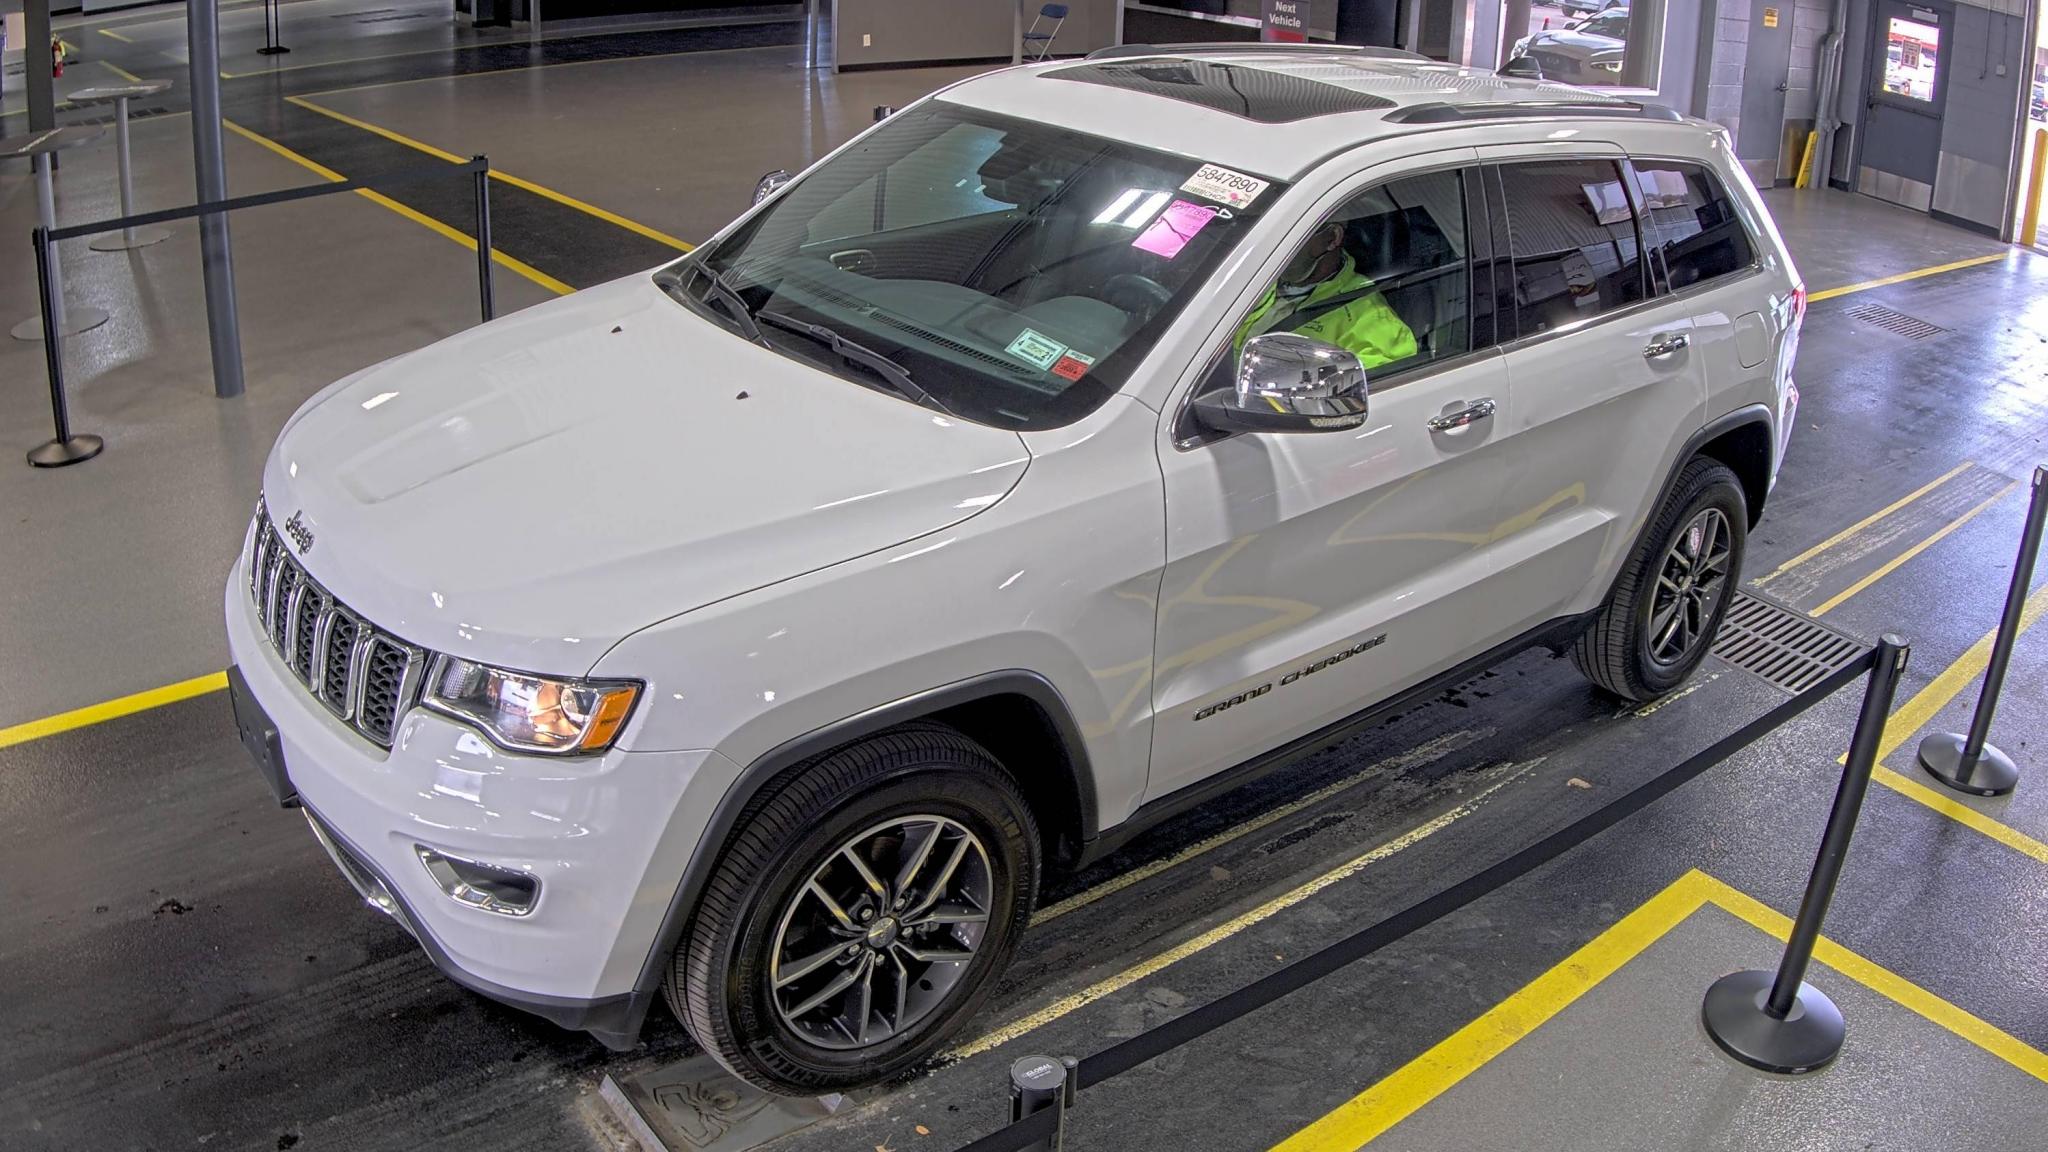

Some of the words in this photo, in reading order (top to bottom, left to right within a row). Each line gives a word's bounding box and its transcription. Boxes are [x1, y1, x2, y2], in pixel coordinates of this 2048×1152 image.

[1268, 13, 1301, 28] Vehicle
[1275, 1, 1296, 13] Next
[1196, 166, 1259, 194] 5847890
[285, 509, 315, 556] Jeep
[1192, 682, 1273, 721] GRAND
[1279, 632, 1387, 687] CHEROKEE
[755, 1042, 836, 1090] ICHELIN
[1025, 1063, 1052, 1078] GLOBAL
